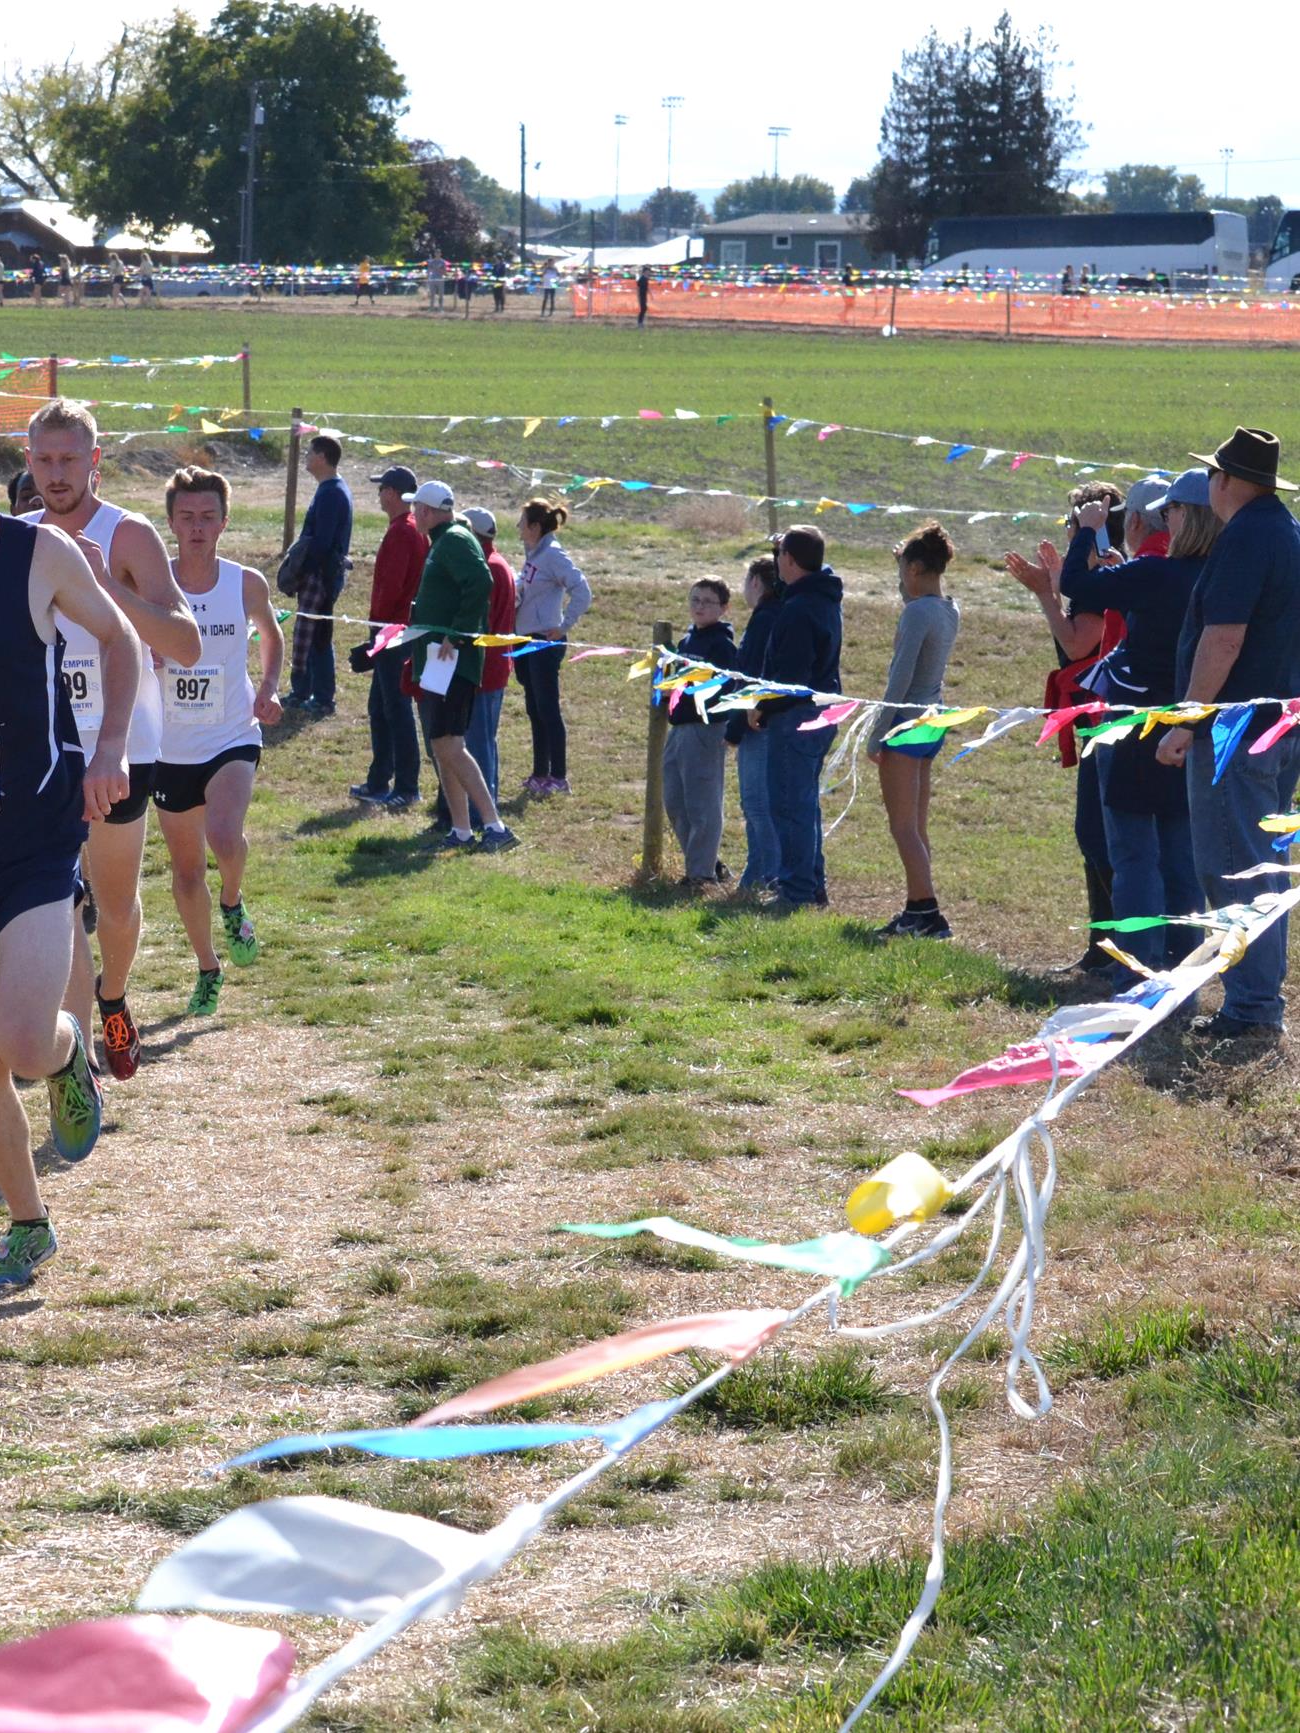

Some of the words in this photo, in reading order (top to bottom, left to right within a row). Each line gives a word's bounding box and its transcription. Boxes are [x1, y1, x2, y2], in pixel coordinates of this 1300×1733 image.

[210, 624, 235, 636] IDAHO
[63, 659, 95, 668] EMPIRE
[168, 668, 192, 676] INLAND
[194, 668, 219, 676] EMPIRE
[176, 678, 210, 701] 897
